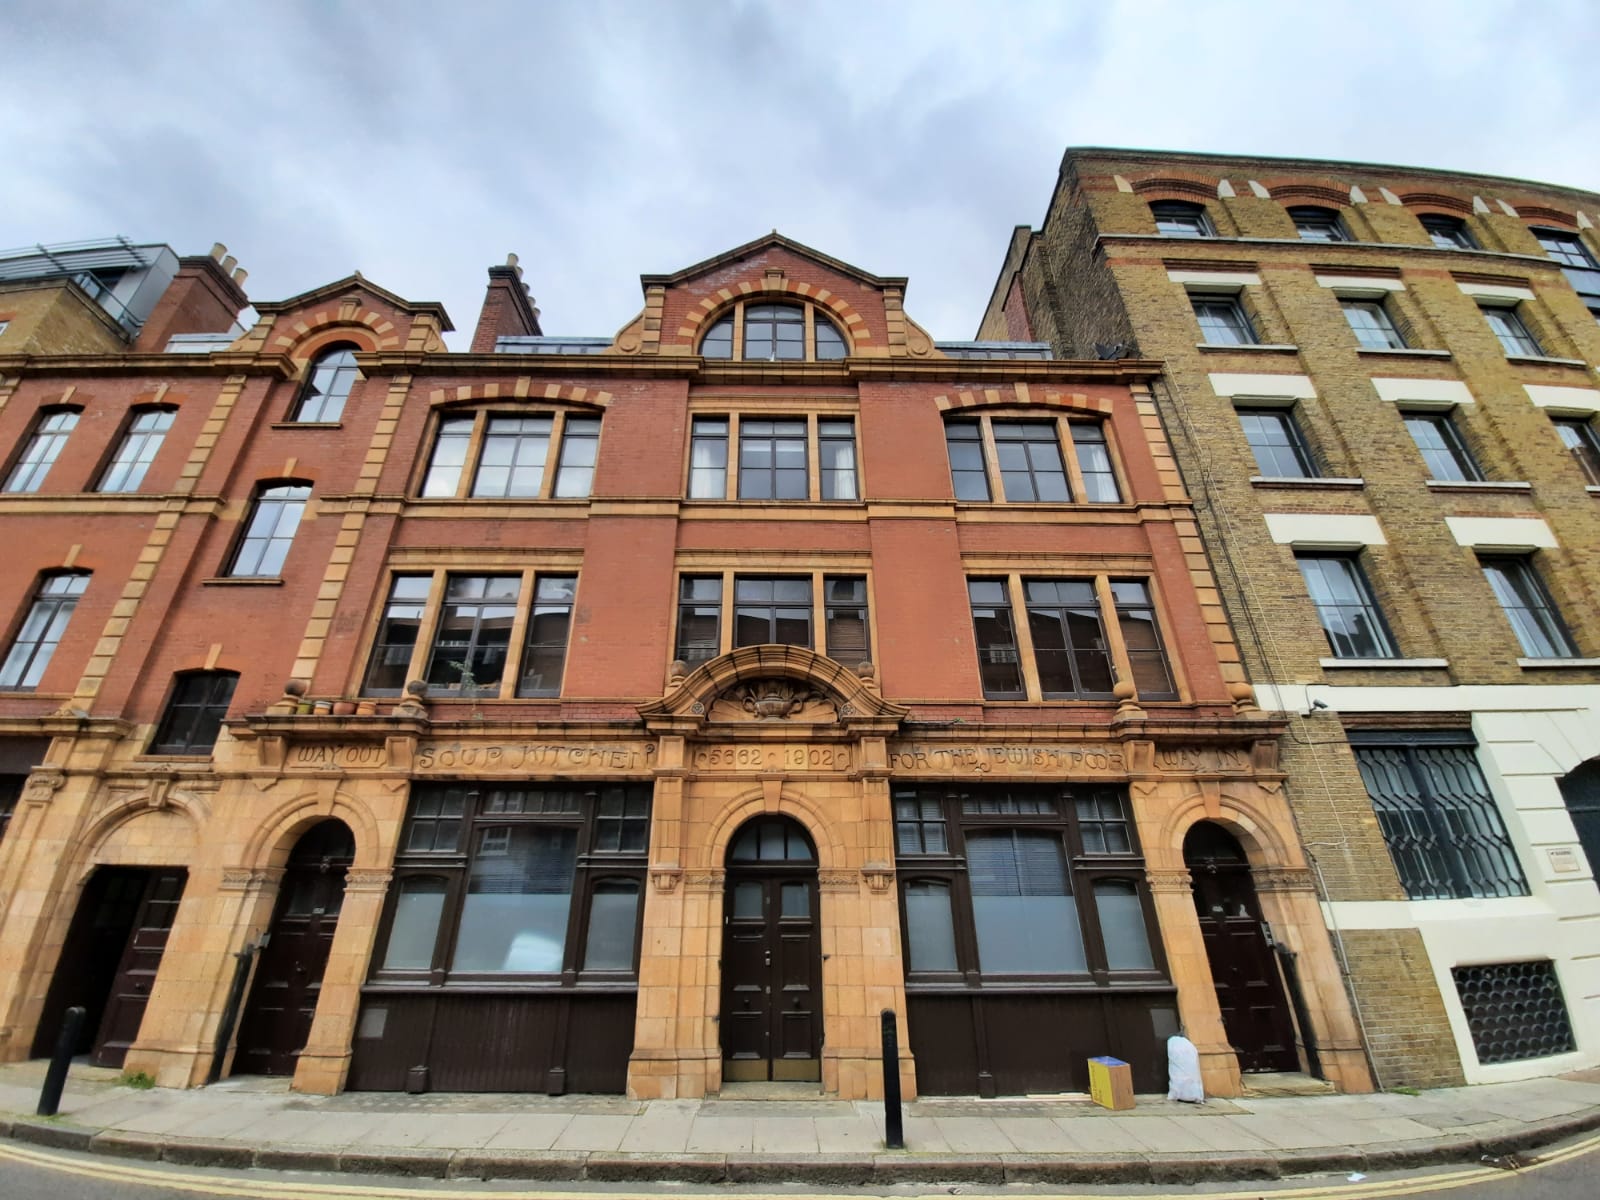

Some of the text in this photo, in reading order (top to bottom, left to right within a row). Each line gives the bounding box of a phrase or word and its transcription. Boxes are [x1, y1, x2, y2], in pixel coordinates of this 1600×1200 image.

[297, 746, 386, 763] WAY OUT
[418, 743, 655, 769] SOUP KITCHEN
[709, 748, 833, 766] 5662 1902
[889, 746, 1128, 773] FOR THE JEWISH POOR
